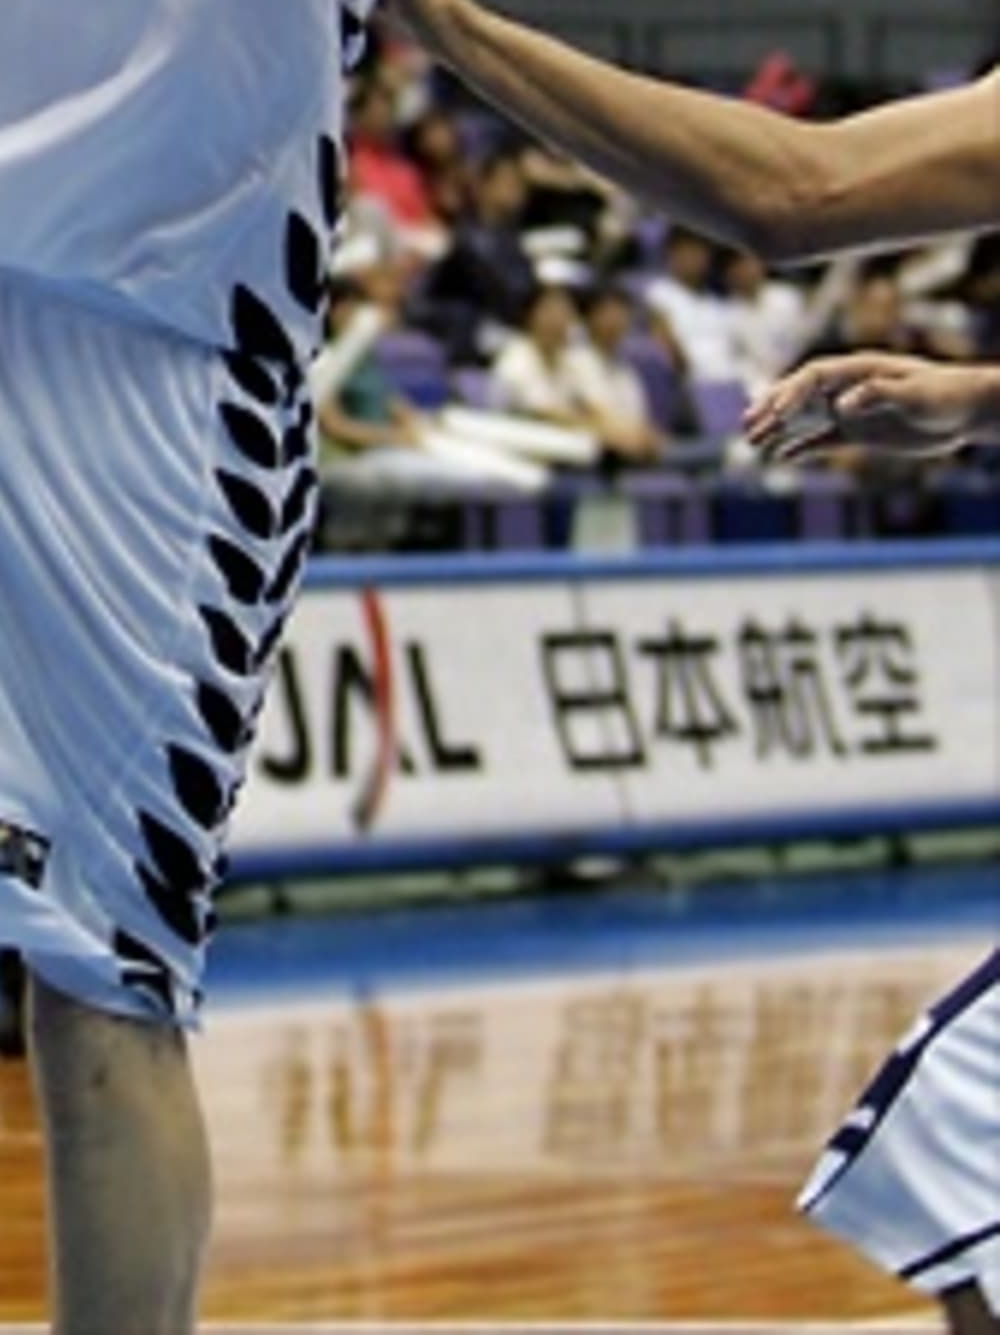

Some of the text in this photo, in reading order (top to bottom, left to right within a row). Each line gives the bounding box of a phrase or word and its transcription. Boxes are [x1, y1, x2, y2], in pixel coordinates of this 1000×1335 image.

[258, 614, 938, 784] JAL 日本航空
